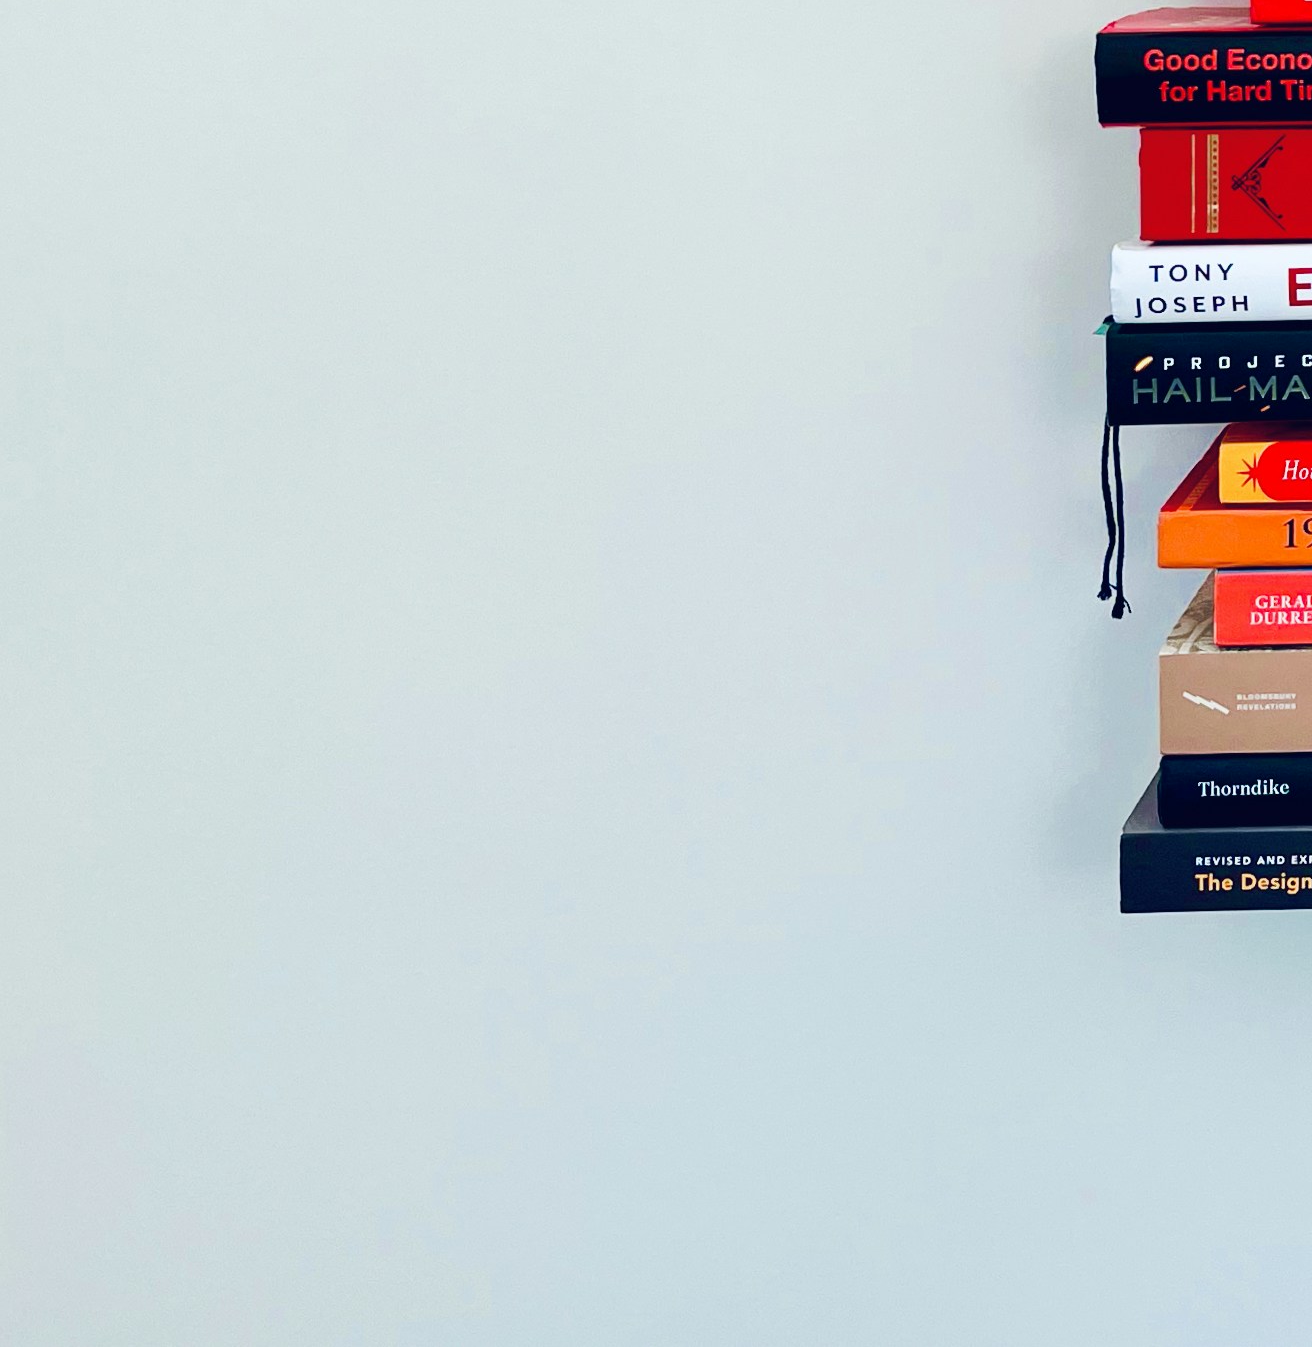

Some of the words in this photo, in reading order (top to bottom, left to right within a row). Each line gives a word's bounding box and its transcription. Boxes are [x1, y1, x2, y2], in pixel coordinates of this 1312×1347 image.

[1144, 48, 1218, 71] Good
[1159, 80, 1198, 102] for
[1207, 80, 1272, 102] Hard
[1148, 263, 1234, 283] TONY
[1134, 295, 1249, 318] JOSEPH
[1133, 376, 1232, 405] HAIL
[1198, 779, 1290, 797] Thorndike
[1196, 856, 1251, 866] REVISED
[1257, 855, 1285, 865] AND
[1195, 873, 1233, 892] The
[1241, 872, 1312, 895] Design
